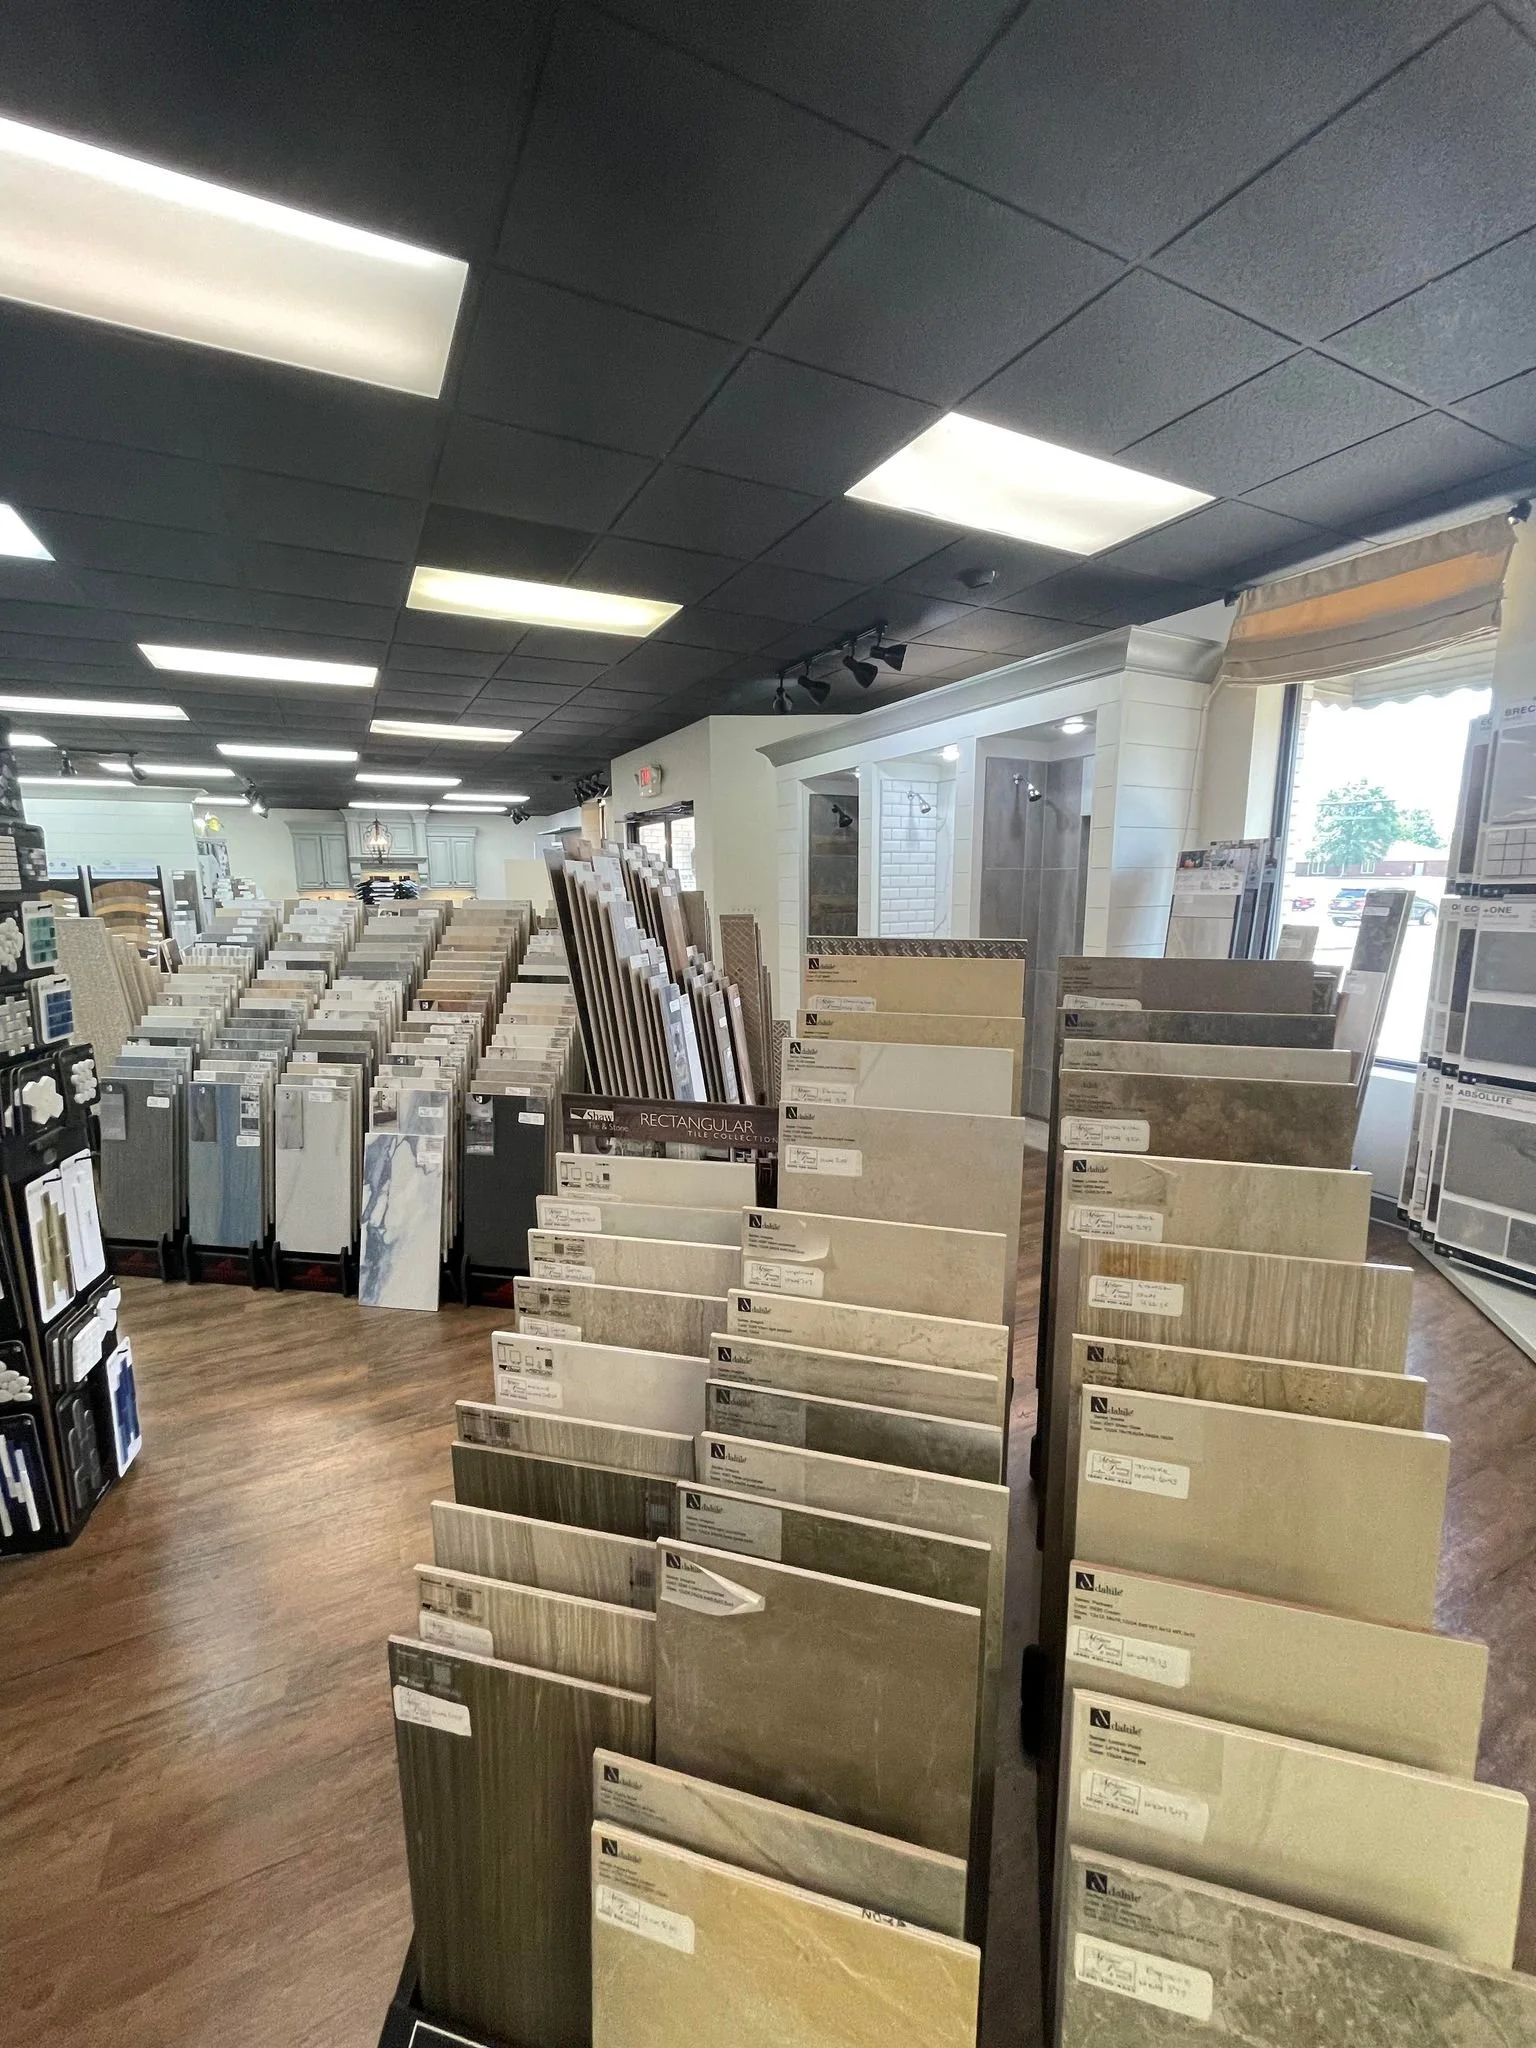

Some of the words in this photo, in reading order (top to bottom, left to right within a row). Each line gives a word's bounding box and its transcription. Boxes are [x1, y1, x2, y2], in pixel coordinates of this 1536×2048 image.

[1457, 1088, 1513, 1105] ABSOLUTE
[586, 1110, 613, 1122] Shaw
[640, 1112, 755, 1134] RECTANGULAR
[587, 1121, 600, 1130] Tile
[608, 1123, 629, 1132] Stone
[687, 1130, 708, 1139] TILE
[713, 1132, 778, 1144] COLLECTION
